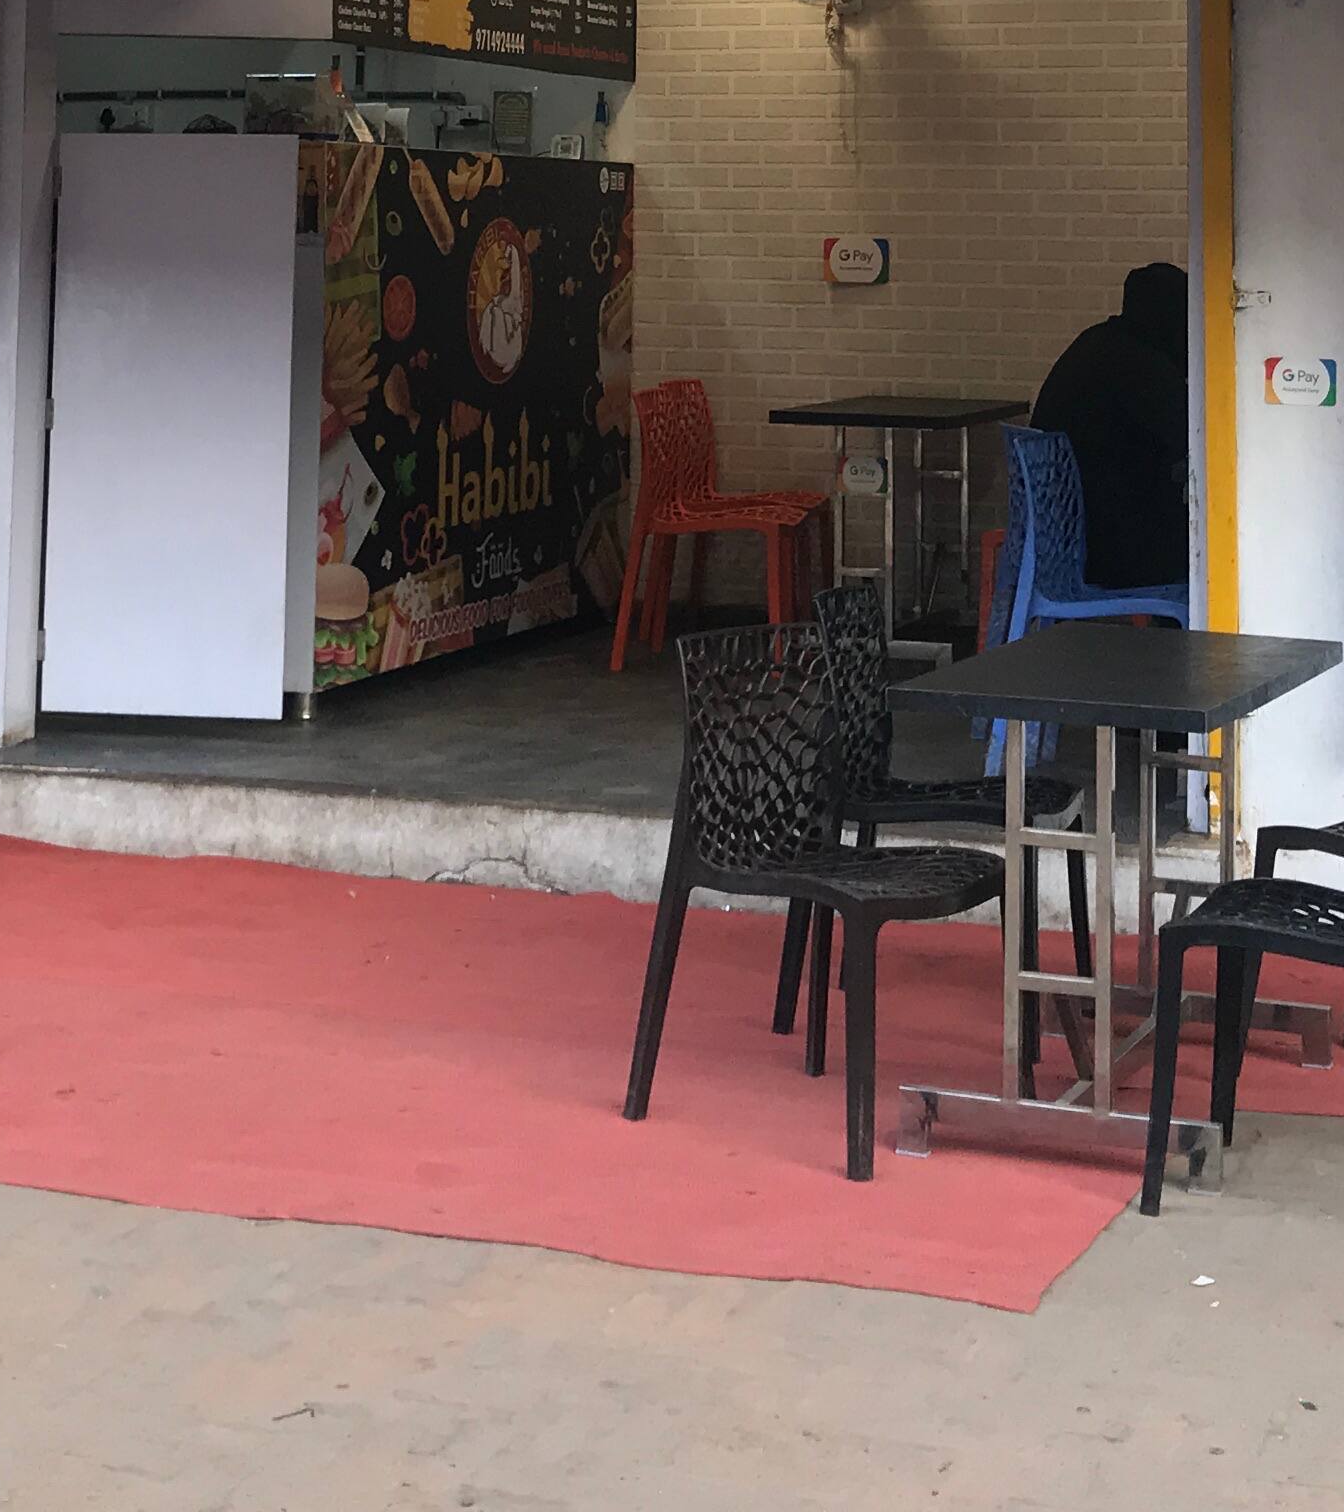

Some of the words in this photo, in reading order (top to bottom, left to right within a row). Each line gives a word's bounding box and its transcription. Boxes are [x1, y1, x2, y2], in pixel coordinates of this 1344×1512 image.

[475, 28, 525, 55] 9714924444
[1297, 369, 1320, 386] Pay
[436, 407, 553, 529] Habibi
